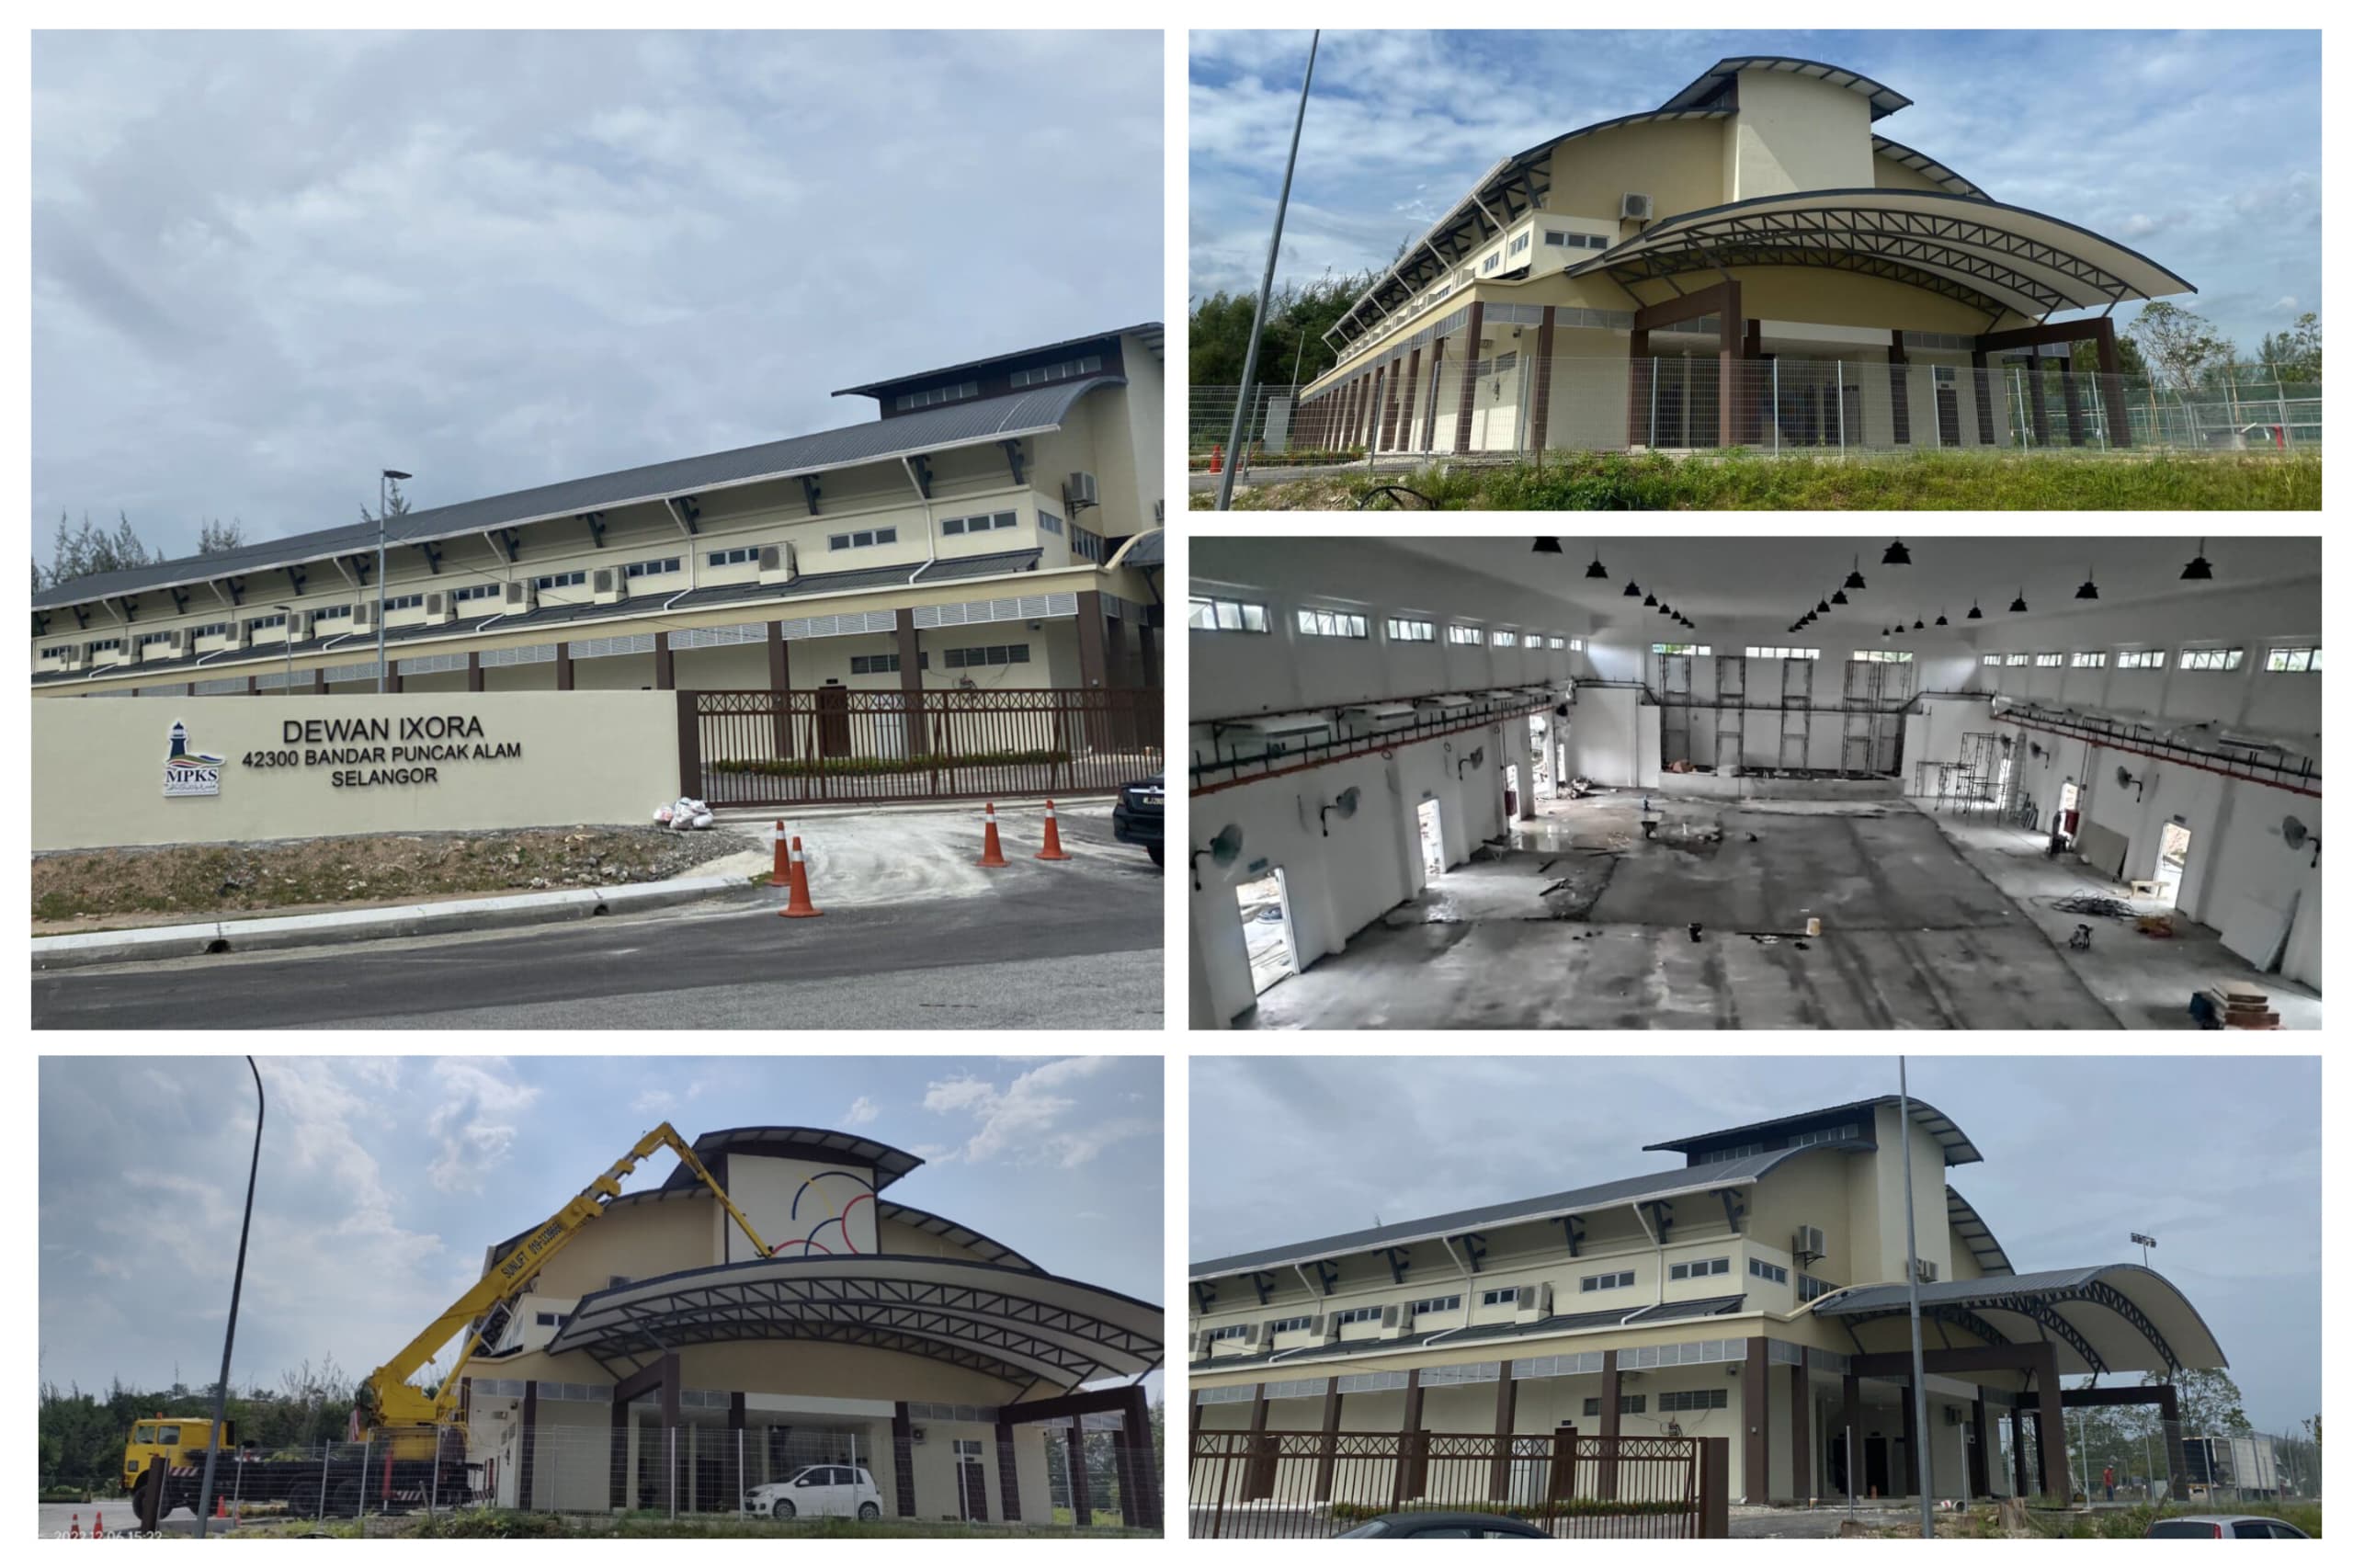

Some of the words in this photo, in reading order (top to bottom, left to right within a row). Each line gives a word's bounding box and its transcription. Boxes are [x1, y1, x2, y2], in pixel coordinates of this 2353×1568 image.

[283, 718, 389, 744] DEWAN
[400, 715, 484, 741] IXORA
[242, 750, 299, 767] 42300
[304, 747, 386, 766] BANDAR
[392, 744, 470, 763] PUNCAK
[472, 742, 521, 759] ALAM
[165, 768, 218, 783] MPKS
[331, 767, 438, 788] SELANGOR
[501, 1251, 530, 1279] SUNLIFT
